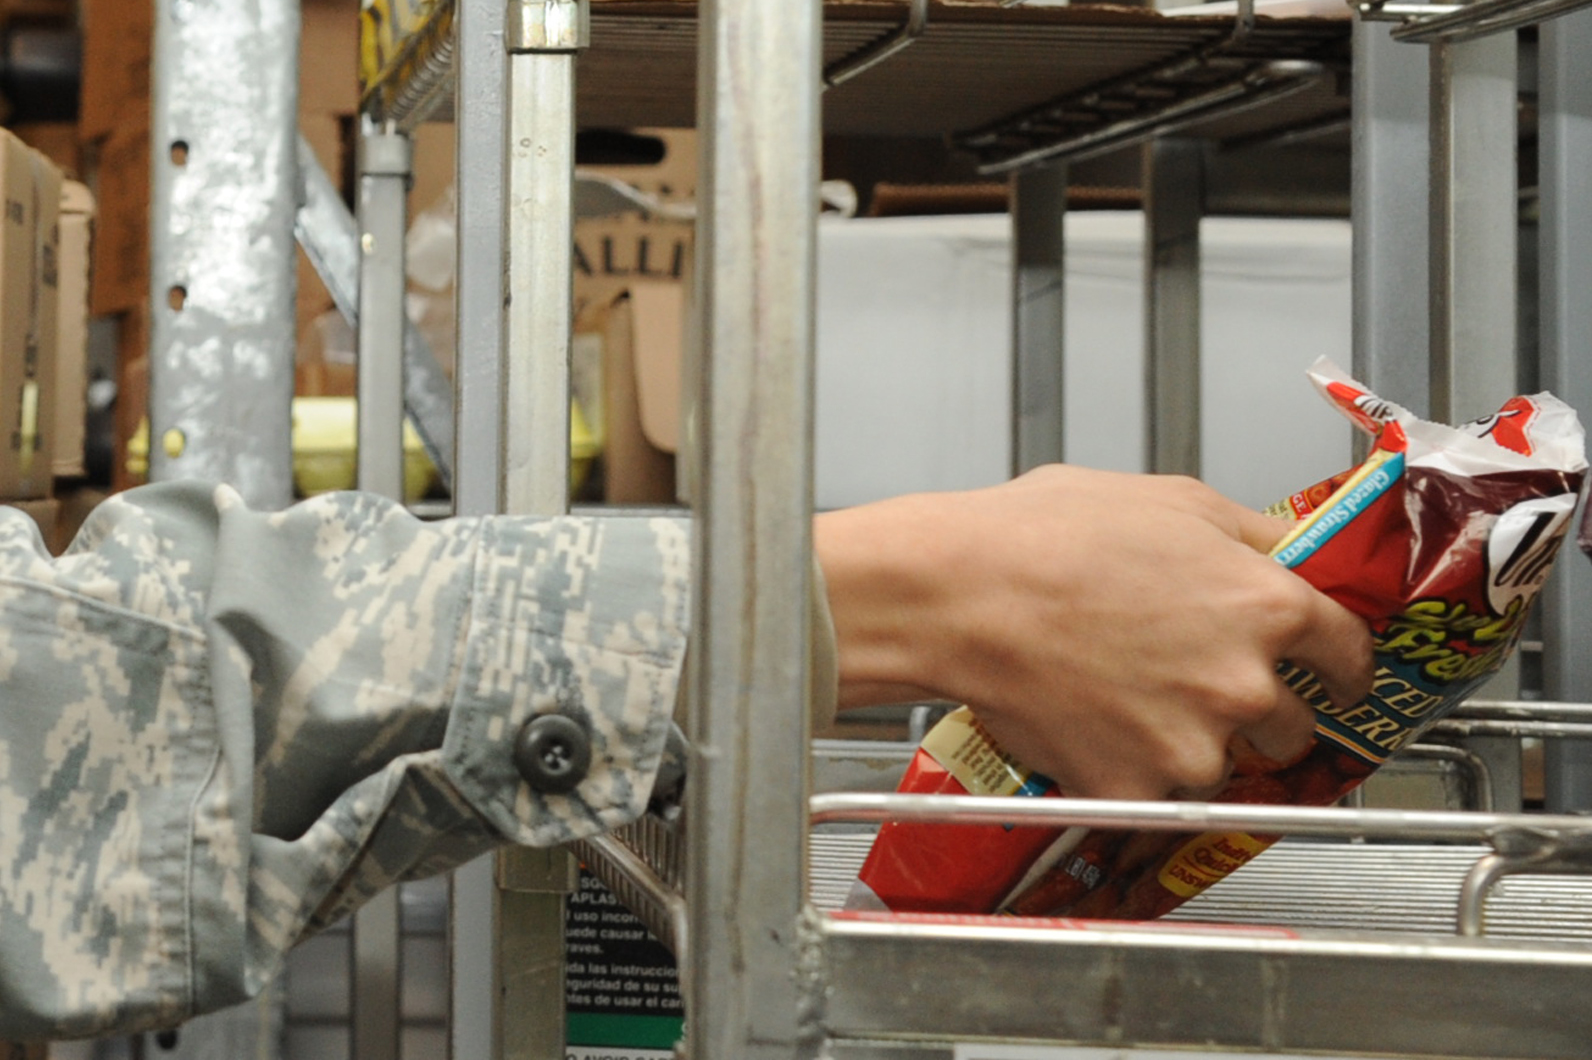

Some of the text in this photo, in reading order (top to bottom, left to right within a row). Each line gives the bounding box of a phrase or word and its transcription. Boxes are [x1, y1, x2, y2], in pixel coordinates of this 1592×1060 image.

[1341, 469, 1390, 513] Glazed
[570, 892, 617, 905] APLAS
[573, 912, 599, 922] uso
[565, 926, 598, 939] uede
[599, 929, 645, 941] causar
[588, 962, 608, 975] las
[623, 979, 640, 992] de
[643, 982, 660, 993] su
[594, 993, 611, 1006] de
[614, 996, 643, 1007] usar
[645, 995, 658, 1008] el
